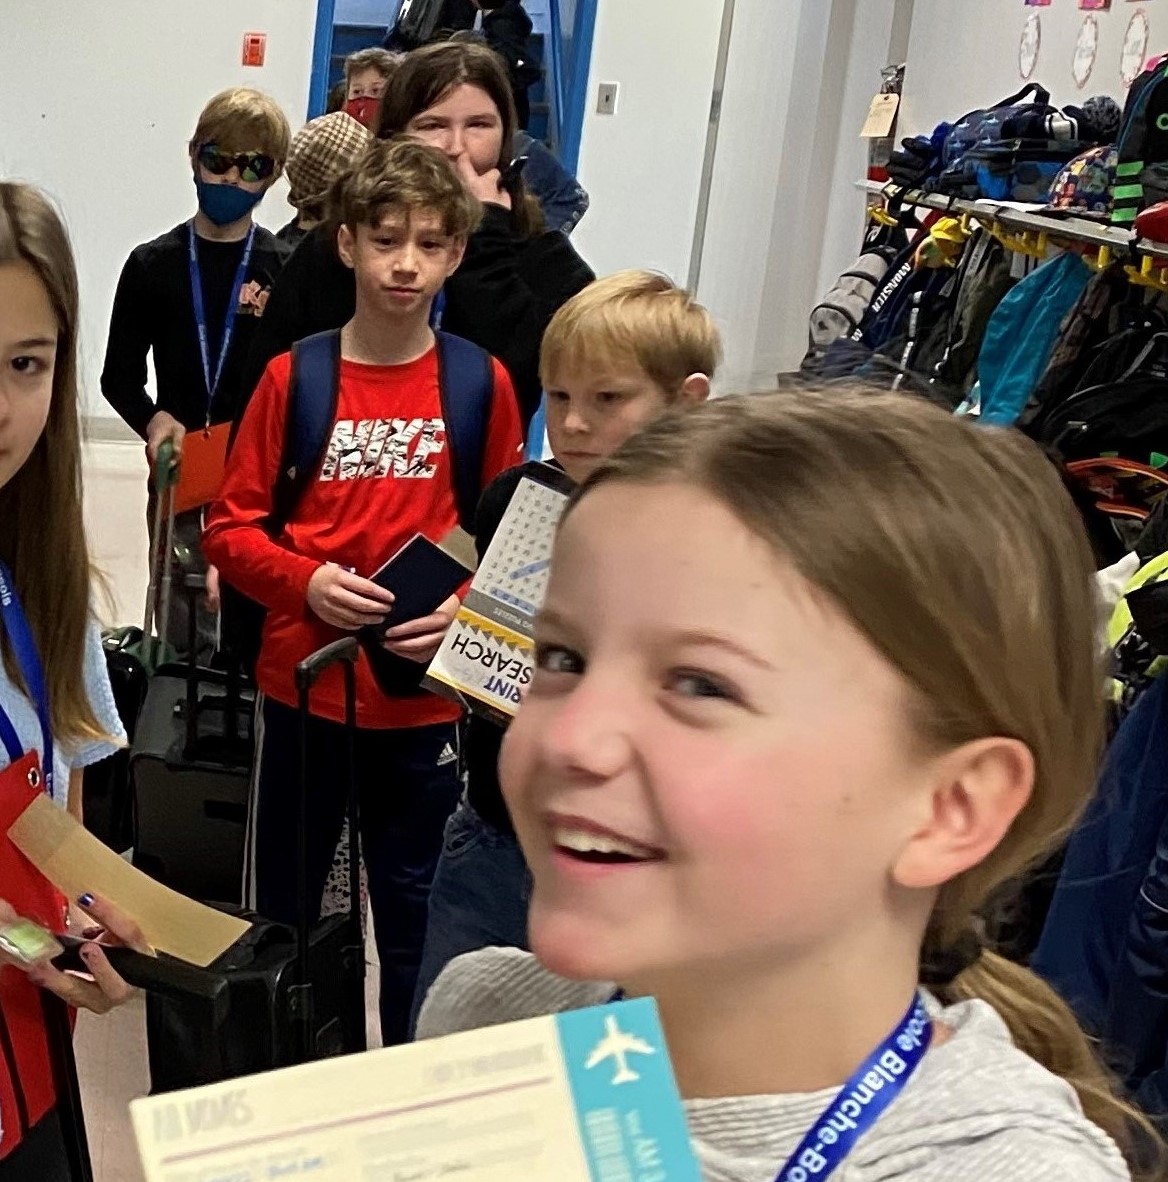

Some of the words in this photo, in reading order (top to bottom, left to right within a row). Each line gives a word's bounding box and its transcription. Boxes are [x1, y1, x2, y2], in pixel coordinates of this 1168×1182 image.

[319, 418, 445, 481] NIKE
[451, 633, 534, 685] SEARCH
[483, 674, 522, 704] RINT
